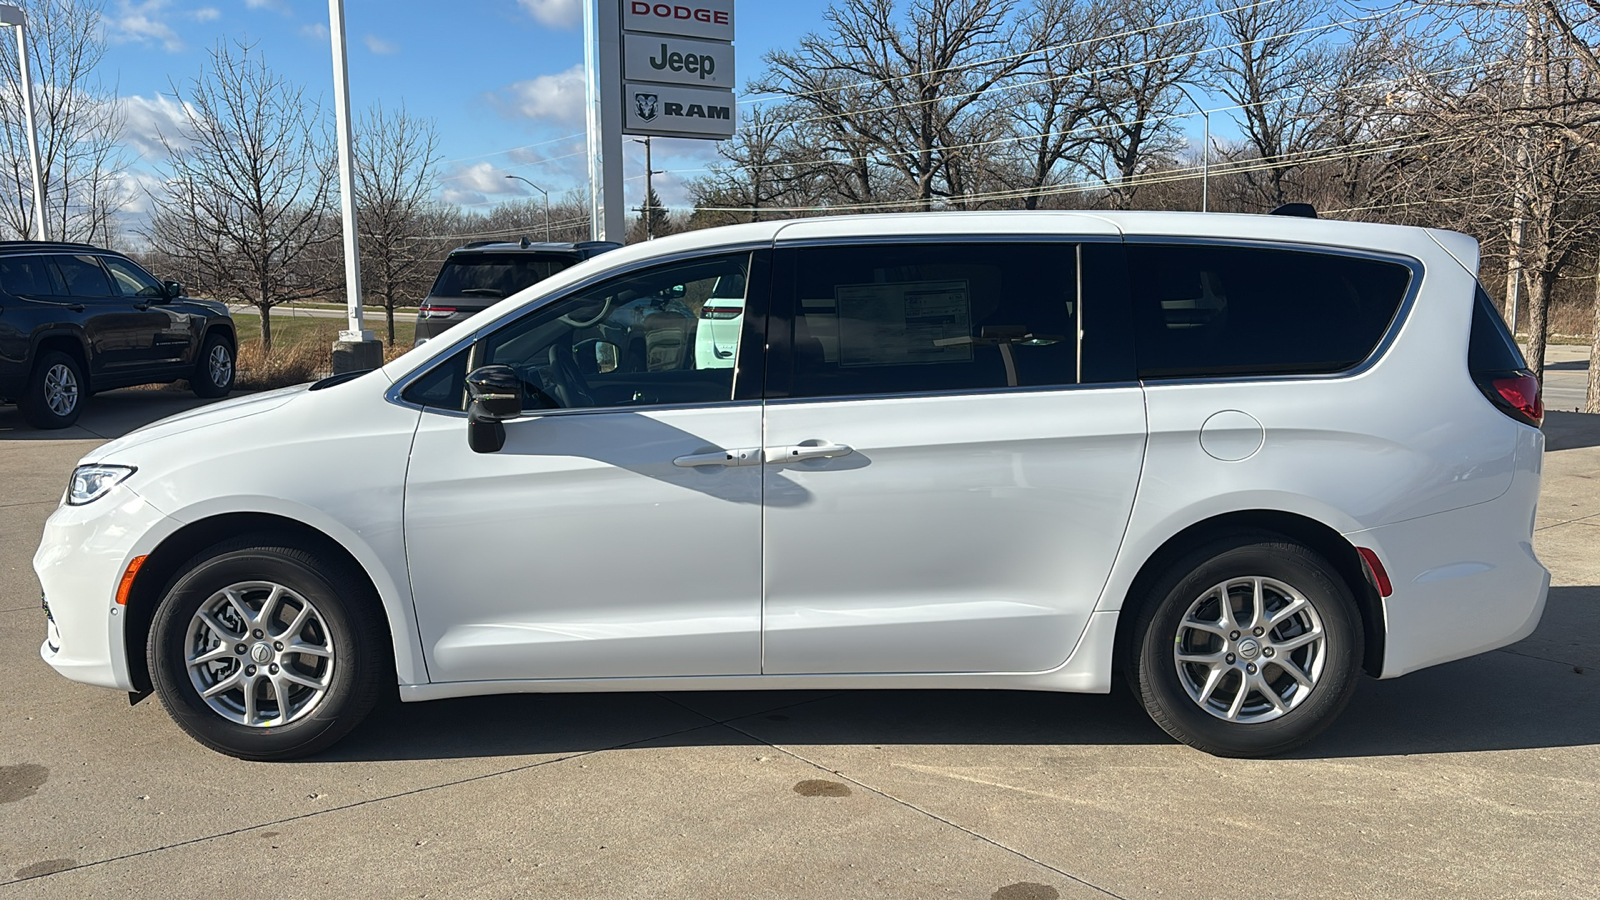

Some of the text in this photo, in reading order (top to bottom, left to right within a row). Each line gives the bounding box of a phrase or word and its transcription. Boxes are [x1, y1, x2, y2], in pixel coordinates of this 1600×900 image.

[631, 1, 729, 25] DODGE
[649, 43, 715, 80] Jeep
[664, 102, 730, 120] RAM
